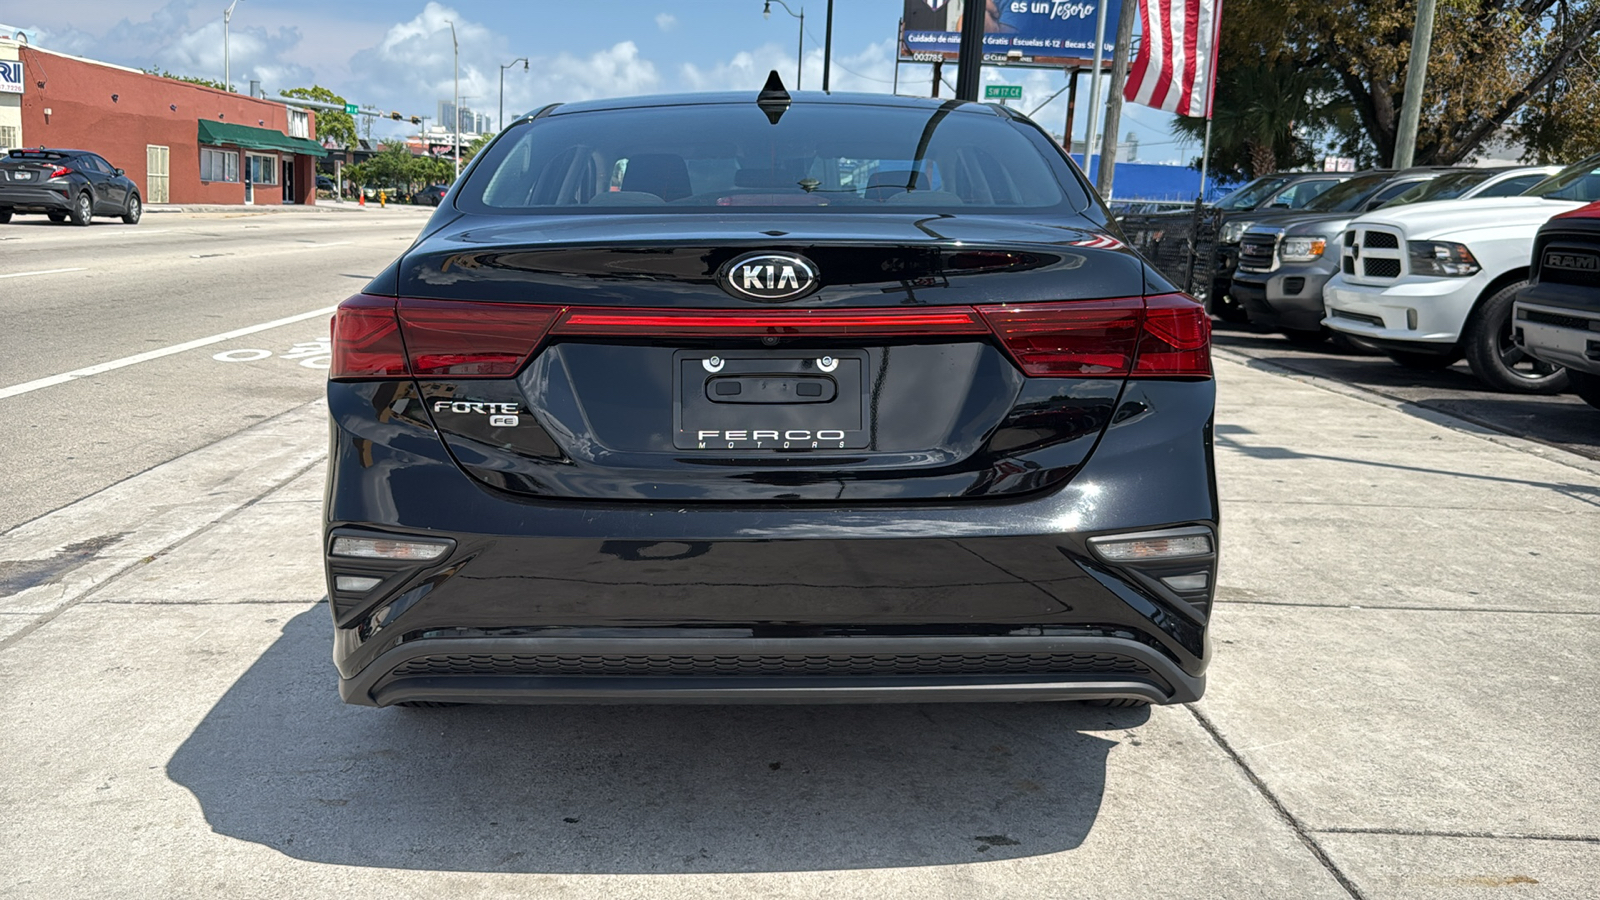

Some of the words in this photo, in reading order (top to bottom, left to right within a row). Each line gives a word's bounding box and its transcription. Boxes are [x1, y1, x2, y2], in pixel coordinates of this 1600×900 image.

[1010, 2, 1027, 13] es
[1031, 3, 1049, 14] un
[1050, 0, 1095, 20] Tesoro
[908, 34, 937, 43] Cuidado
[987, 37, 1009, 46] Gratis
[1013, 38, 1044, 47] Escuelas
[1044, 40, 1060, 48] K-12
[1064, 40, 1086, 49] Becas
[913, 52, 943, 62] 003785
[988, 88, 1000, 96] SW
[1549, 255, 1595, 269] RAM
[743, 265, 799, 289] KIA
[434, 401, 519, 414] FORTE
[494, 417, 514, 425] FE
[698, 430, 845, 441] FERCO
